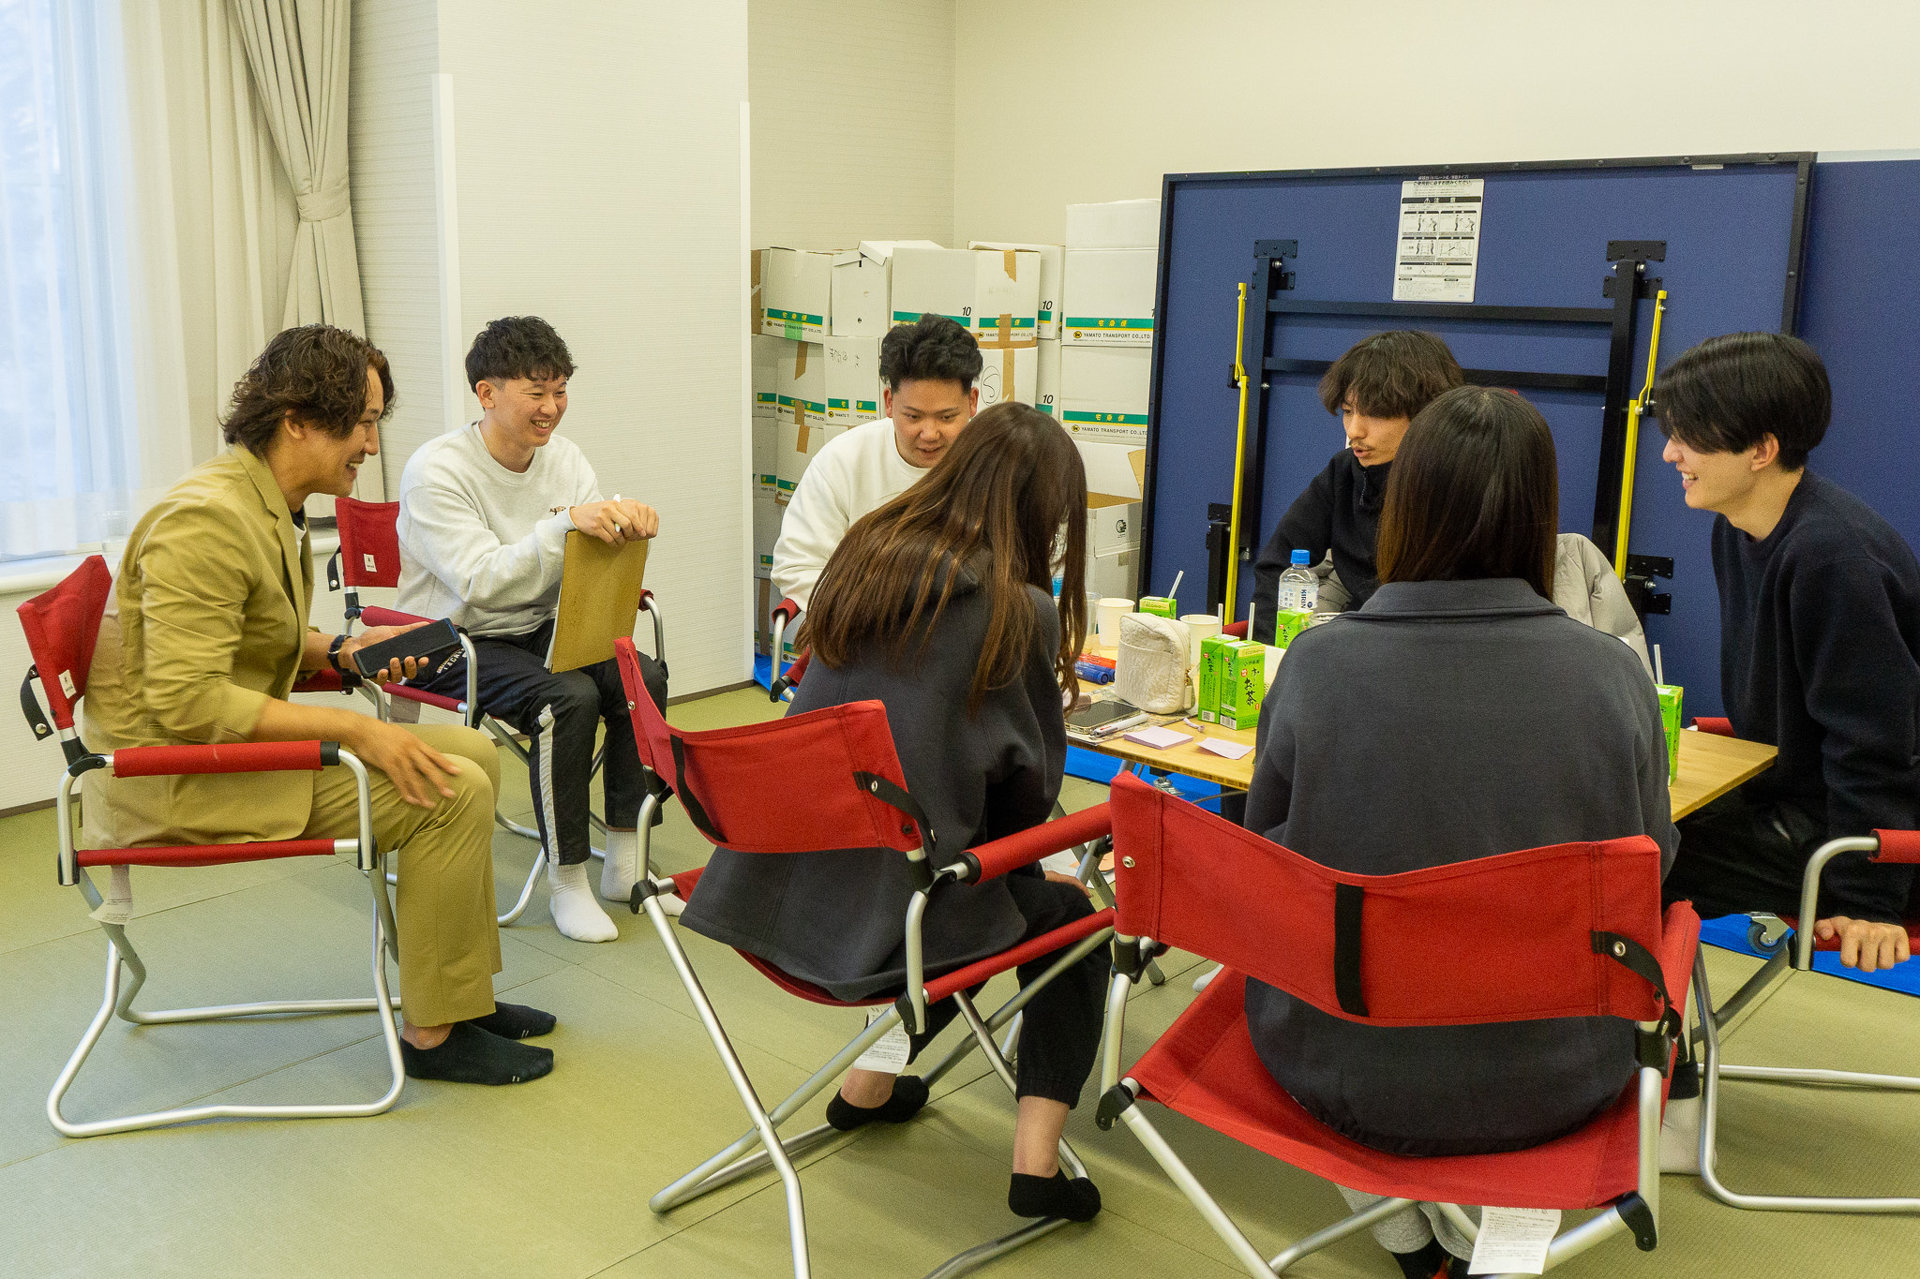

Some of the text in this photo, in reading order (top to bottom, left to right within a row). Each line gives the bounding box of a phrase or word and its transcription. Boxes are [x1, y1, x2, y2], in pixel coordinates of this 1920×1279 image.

[1042, 300, 1053, 310] 10
[962, 306, 972, 316] 10
[1043, 394, 1054, 405] 10
